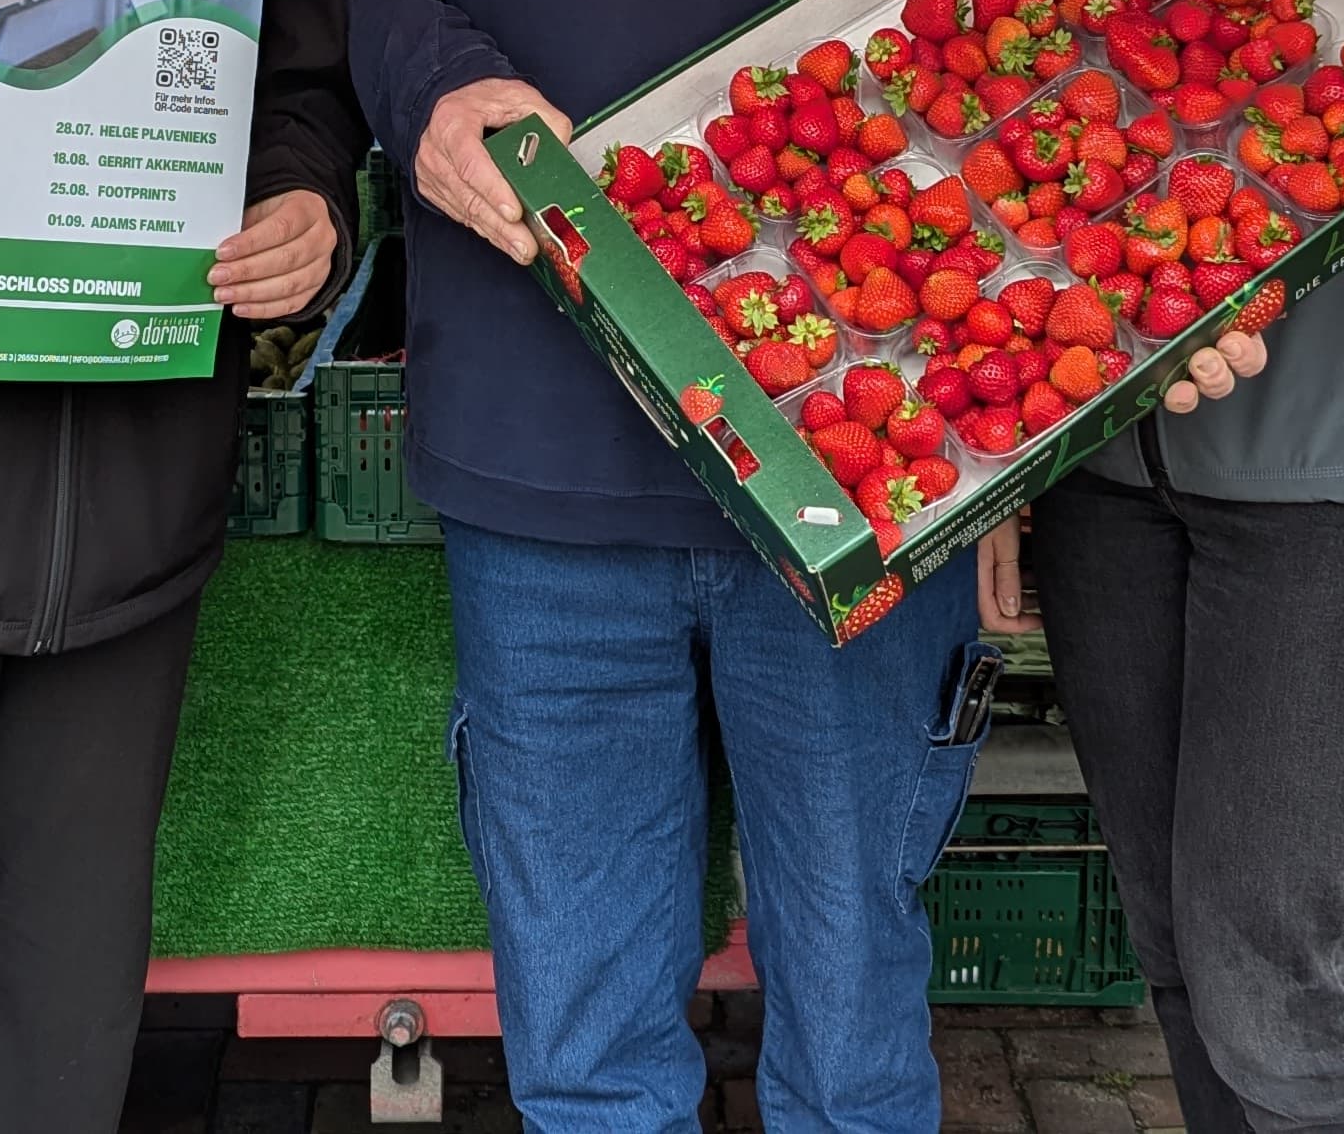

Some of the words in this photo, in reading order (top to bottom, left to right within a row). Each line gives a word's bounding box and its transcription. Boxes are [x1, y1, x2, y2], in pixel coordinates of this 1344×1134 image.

[154, 102, 191, 113] QR-Code
[193, 106, 228, 116] scannen
[155, 92, 169, 102] Für
[171, 94, 192, 104] mehr
[194, 95, 215, 106] Infos
[56, 121, 94, 136] 28.07.
[99, 125, 138, 139] HELGE
[141, 128, 217, 144] PLAVENIEKS
[53, 151, 89, 166] 18.08.
[98, 155, 143, 170] GERRIT
[145, 158, 224, 174] AKKERMANN
[50, 182, 89, 196] 25.08.
[98, 185, 177, 201] FOOTPRINTS
[48, 213, 85, 227] 01.09.
[90, 216, 136, 230] ADAMS
[139, 219, 186, 233] FAMILY
[73, 279, 142, 297] DORNUM
[1295, 275, 1321, 300] DIE
[142, 318, 201, 345] dornum
[40, 355, 68, 364] DORNUM
[908, 516, 965, 561] ERDBEEREN
[966, 499, 985, 517] AUS
[986, 449, 1053, 503] DEUTSCHLAND
